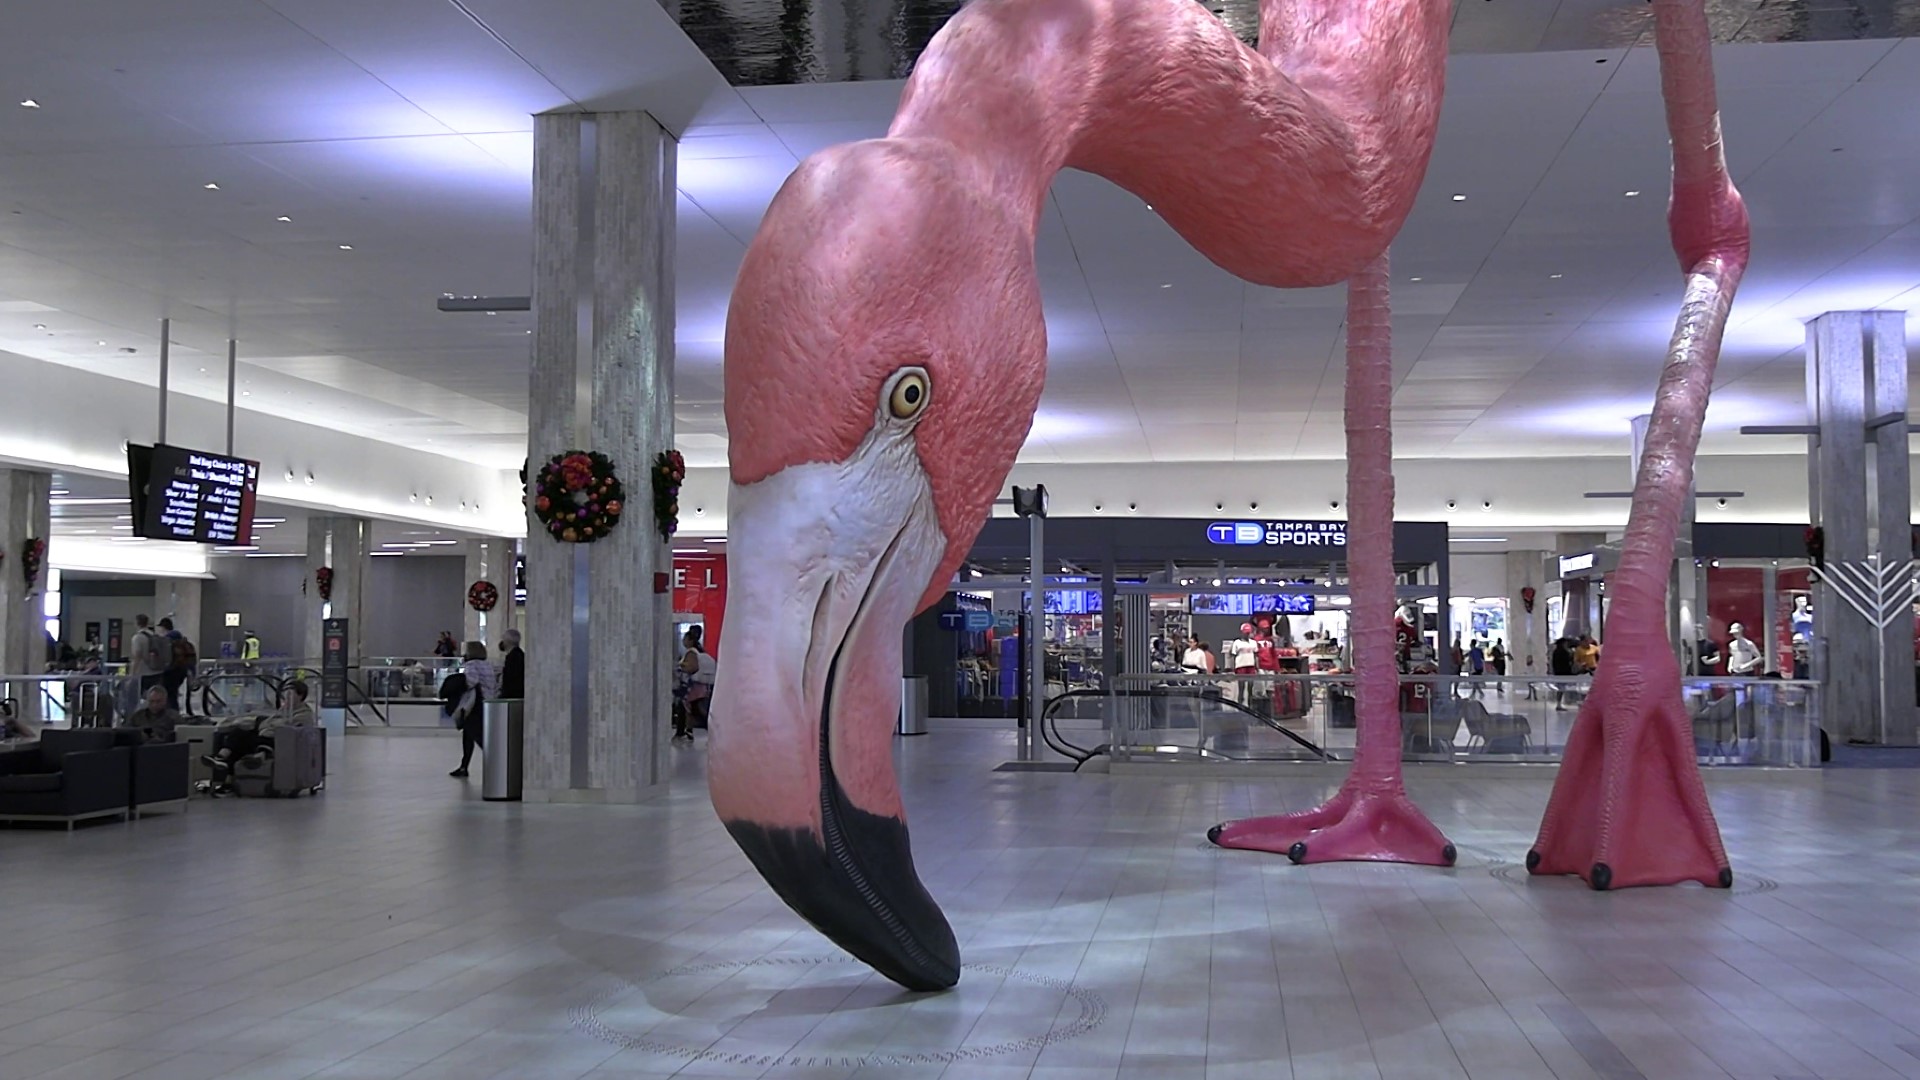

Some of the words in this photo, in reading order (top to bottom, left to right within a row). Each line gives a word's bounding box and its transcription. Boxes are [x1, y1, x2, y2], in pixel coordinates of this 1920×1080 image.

[1209, 524, 1262, 542] TB
[1266, 522, 1312, 530] TAMPA
[1319, 523, 1346, 531] BAY
[1265, 532, 1346, 545] SPORTS
